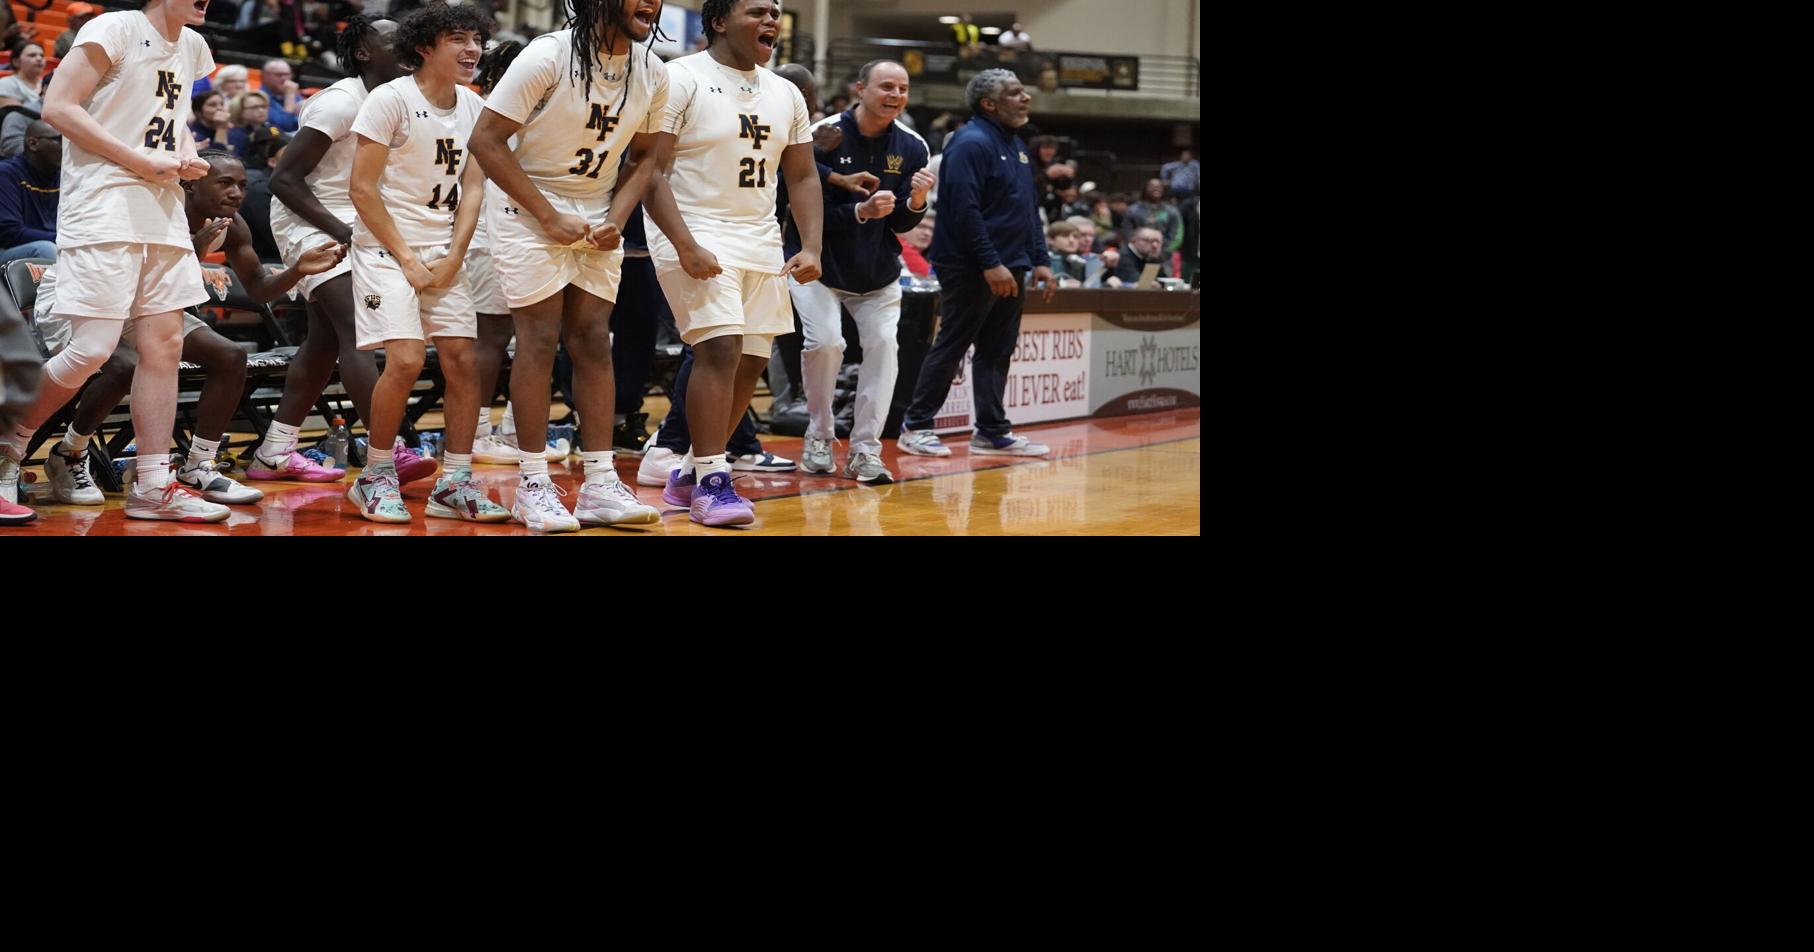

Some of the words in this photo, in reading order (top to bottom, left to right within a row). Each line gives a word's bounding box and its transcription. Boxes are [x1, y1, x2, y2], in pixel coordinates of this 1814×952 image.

[156, 70, 182, 110] NF
[144, 116, 176, 151] 24
[585, 102, 620, 142] NF
[738, 113, 771, 150] NF
[434, 138, 463, 176] NF
[568, 147, 609, 179] 31
[738, 157, 766, 188] 21
[427, 183, 459, 212] 14
[1012, 329, 1050, 362] BEST
[1052, 328, 1084, 360] RIBS
[1105, 348, 1138, 378] HART
[1156, 345, 1199, 374] HOTELS
[1020, 373, 1061, 407] EVER
[1063, 370, 1086, 402] eat!
